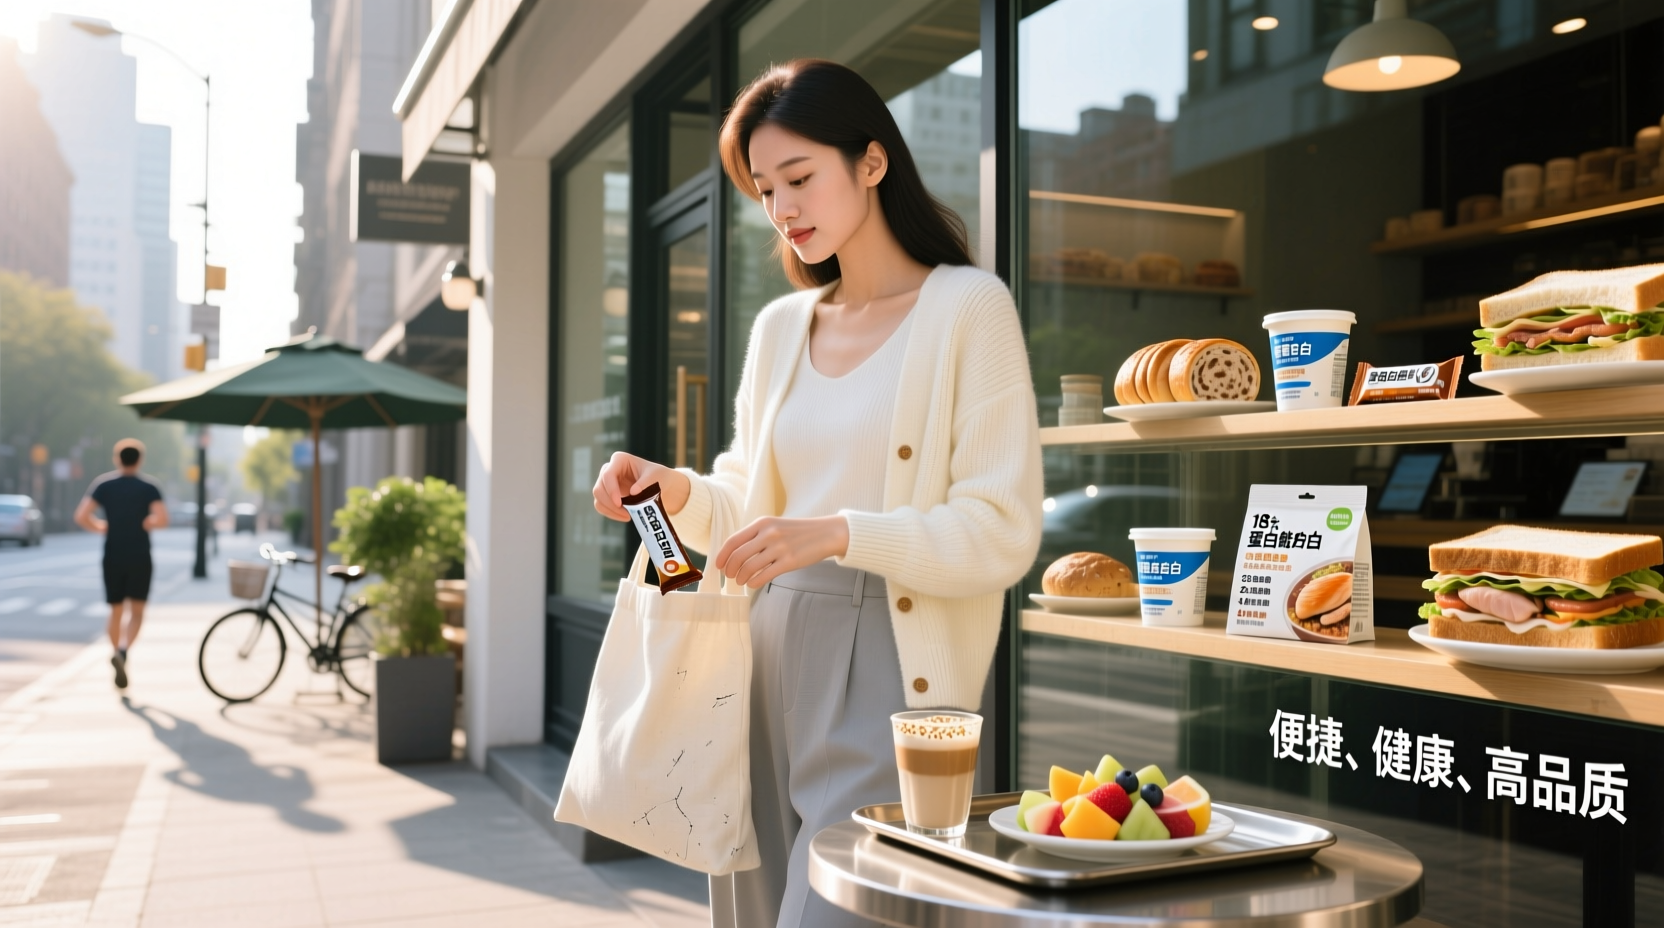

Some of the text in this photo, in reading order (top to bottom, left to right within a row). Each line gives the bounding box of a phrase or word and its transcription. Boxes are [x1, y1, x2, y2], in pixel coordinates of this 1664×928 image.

[1269, 709, 1629, 825] 便捷、健康、高品质
